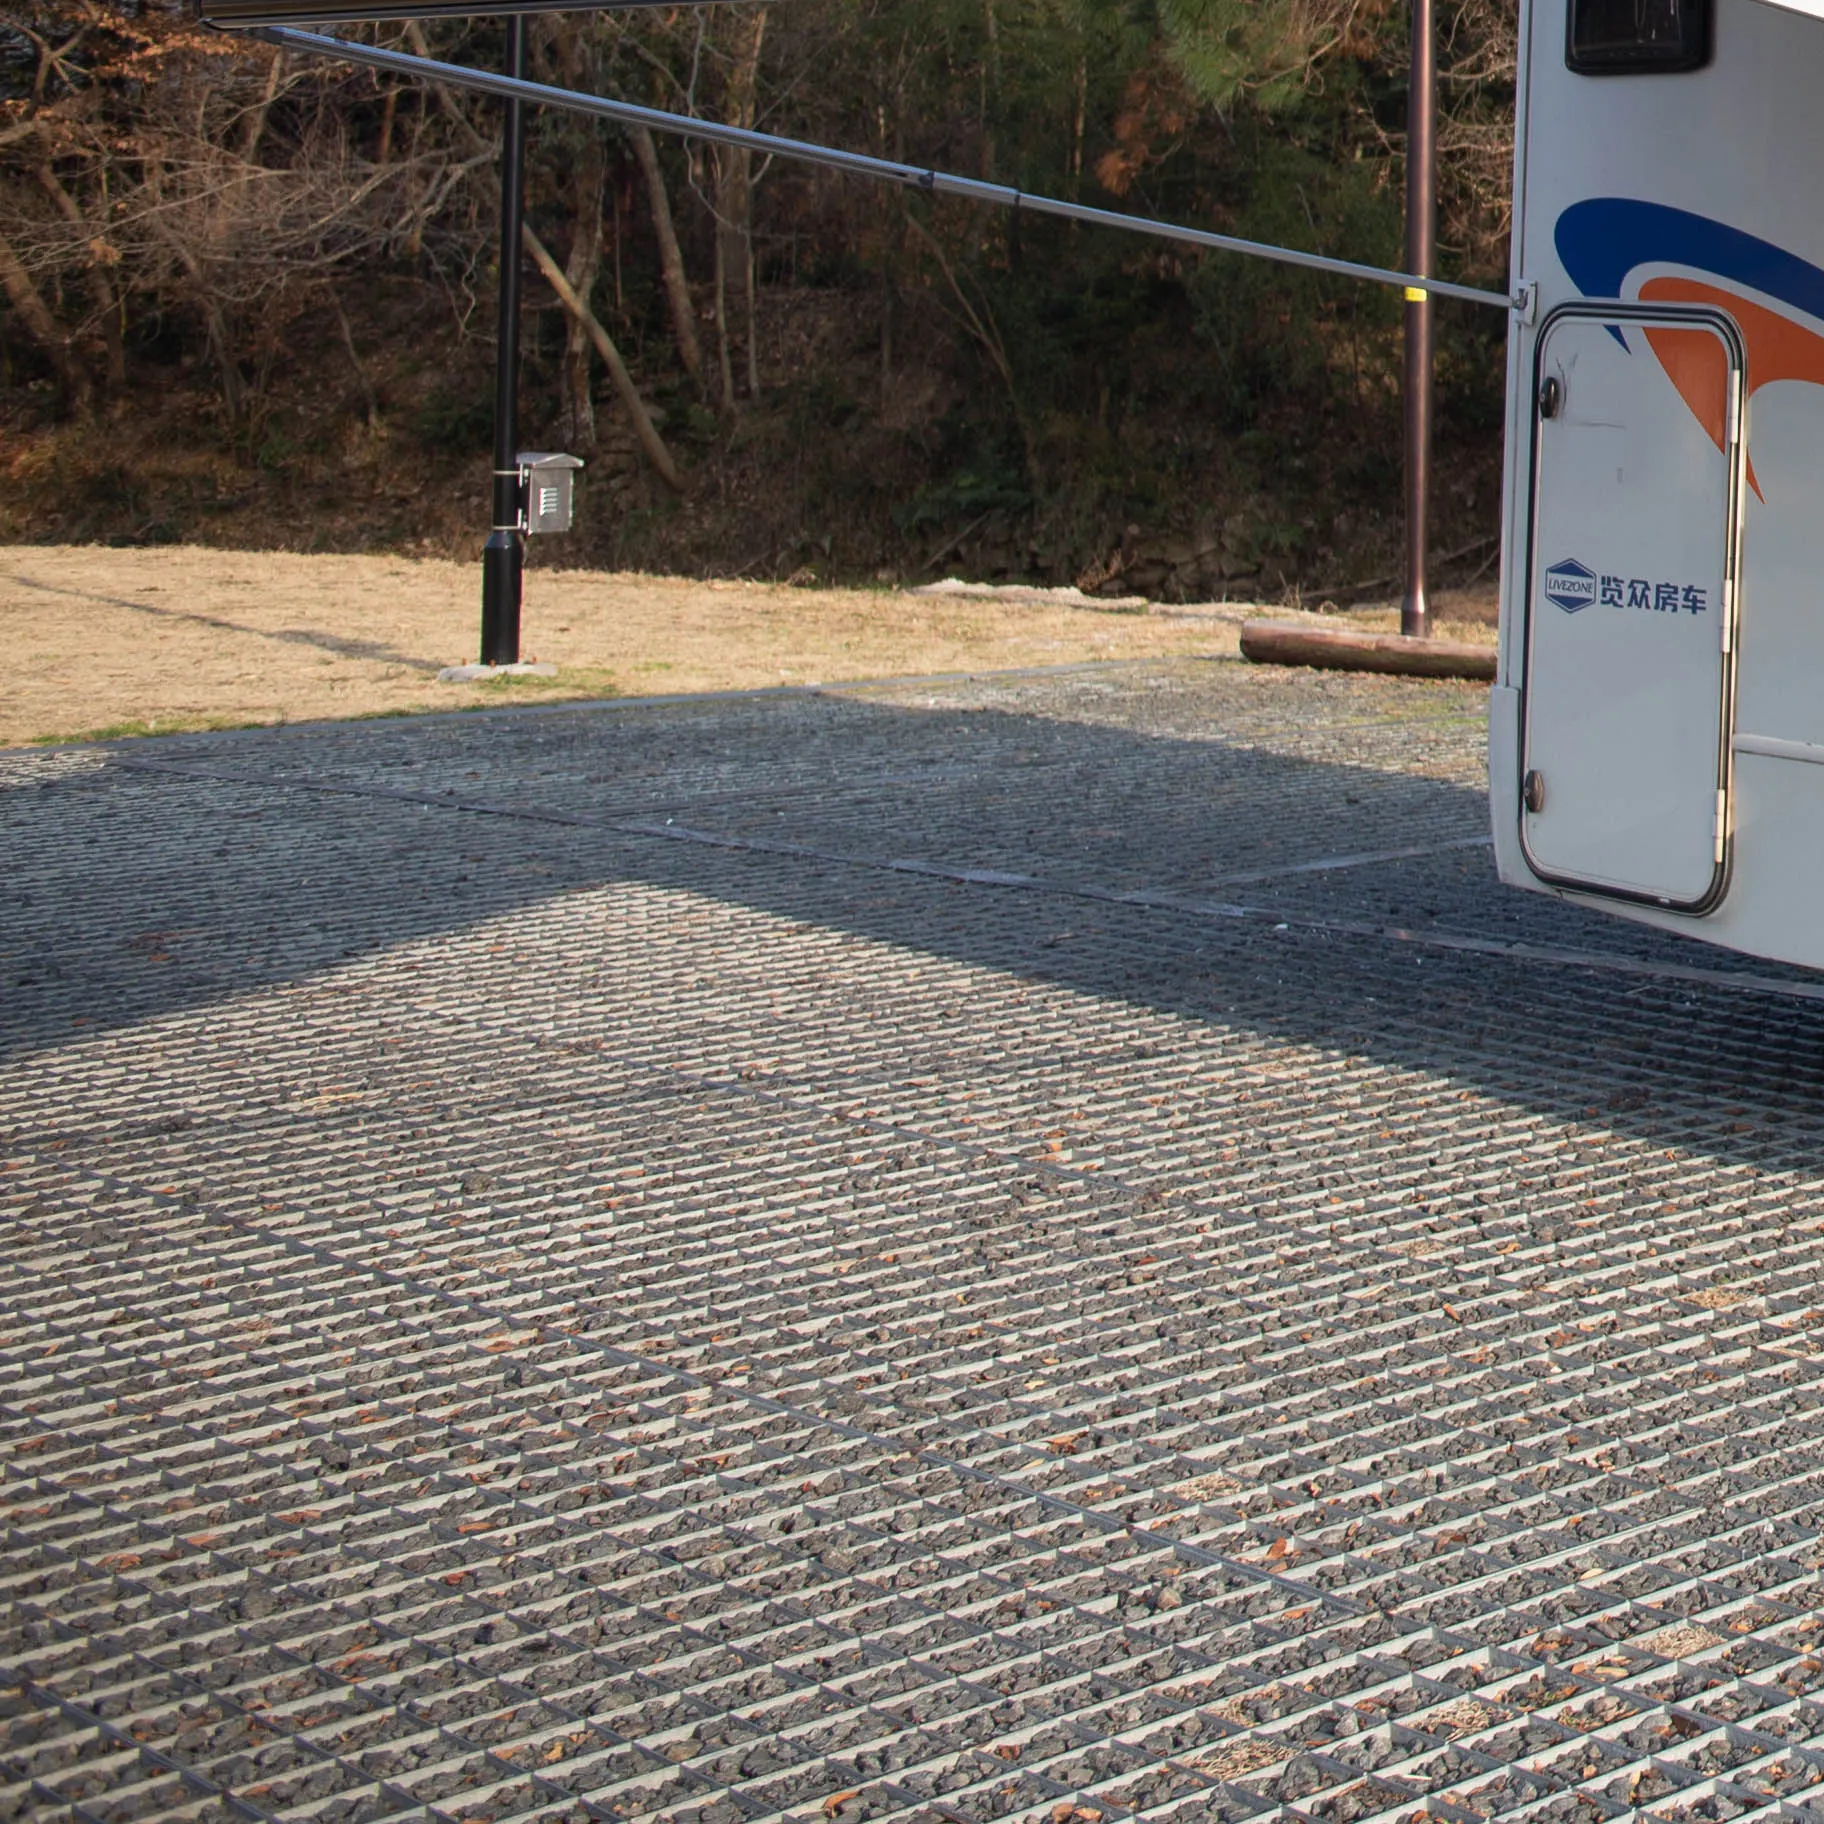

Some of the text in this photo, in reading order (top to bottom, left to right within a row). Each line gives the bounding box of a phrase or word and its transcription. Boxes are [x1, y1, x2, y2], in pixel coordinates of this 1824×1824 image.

[1547, 577, 1594, 594] LIVEZONE
[1600, 575, 1708, 616] 览众房车
